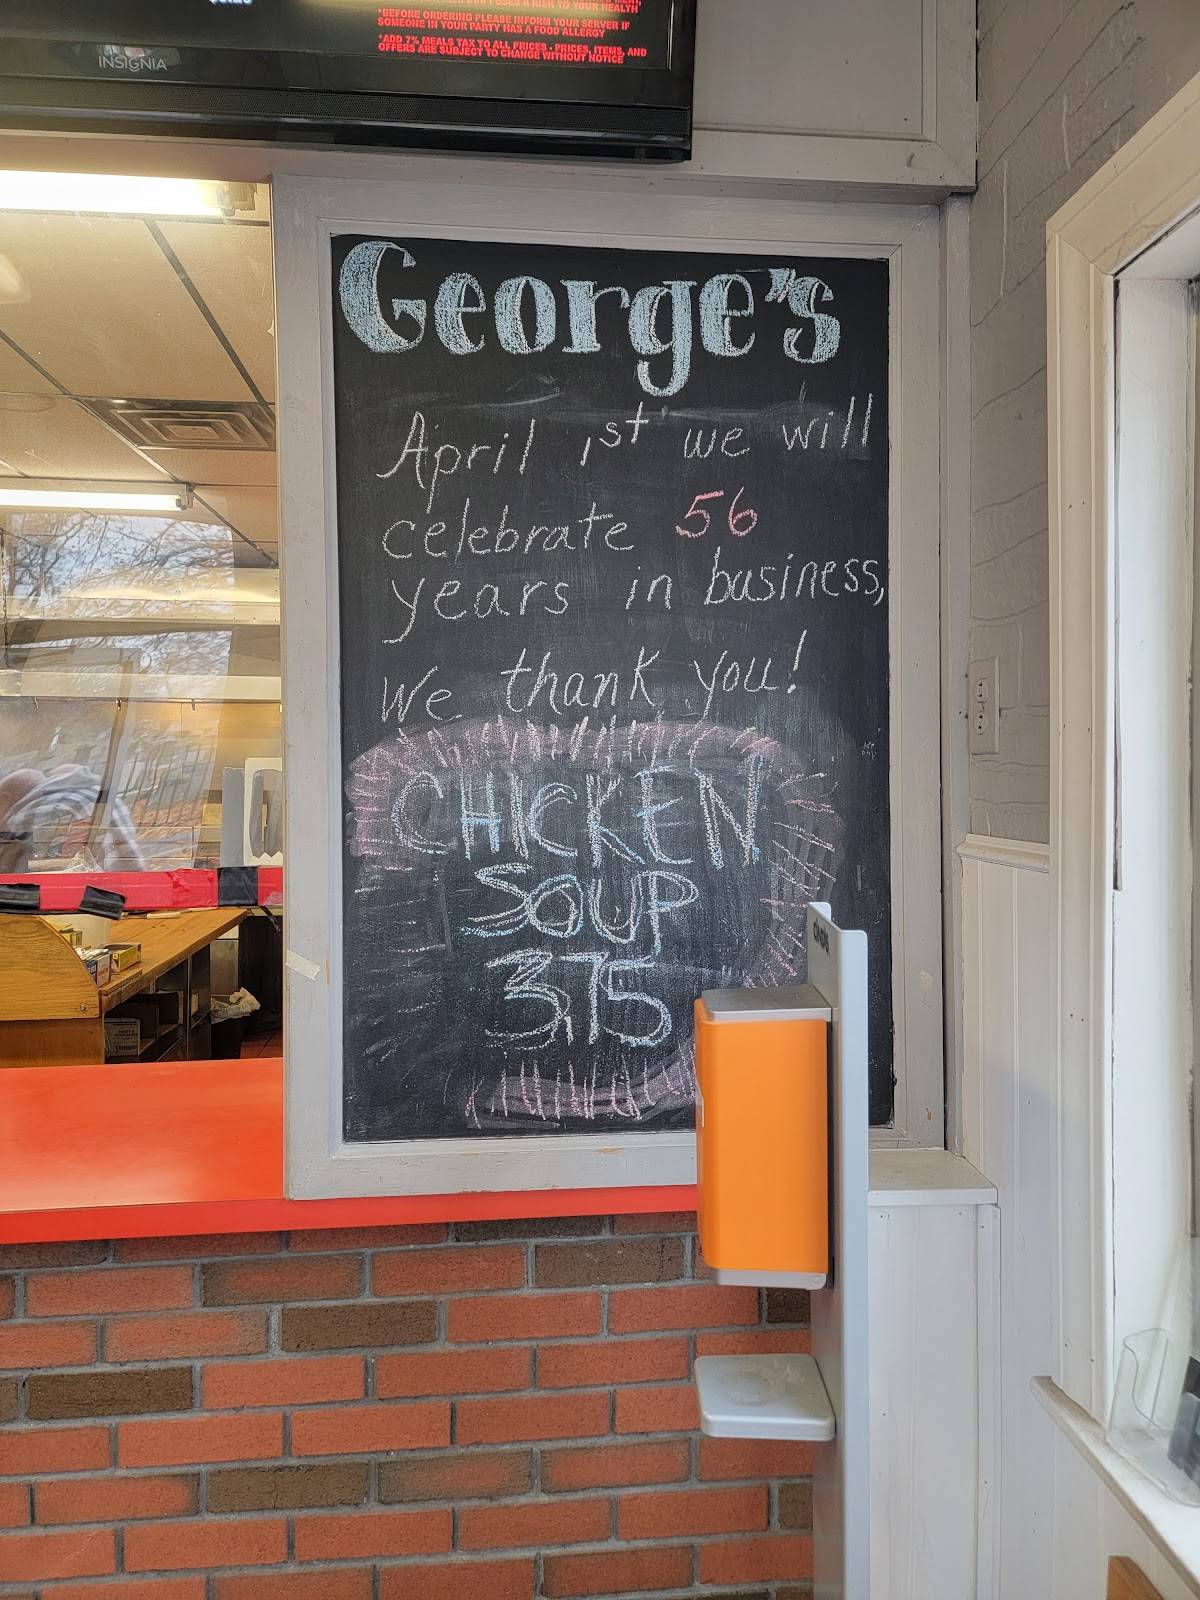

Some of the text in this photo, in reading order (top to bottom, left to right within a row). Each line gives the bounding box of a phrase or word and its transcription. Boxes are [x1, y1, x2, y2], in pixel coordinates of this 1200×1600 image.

[377, 17, 605, 38] SOMEONE IN YOUR PARTY HAS A FOOD ALLERGY
[423, 11, 473, 22] ORDERING
[475, 13, 511, 24] PLEASE
[514, 15, 551, 26] INFORM
[554, 18, 580, 28] YOUR
[582, 20, 618, 30] SERVER
[621, 21, 631, 31] IF
[571, 2, 599, 11] YOUR
[600, 4, 639, 13] HEALTH
[98, 55, 168, 72] INSIGNIA
[378, 43, 624, 64] OFFERS ARE SUBJECT TO CHANGE WITHOUT NOTICE
[405, 35, 419, 45] 7%
[422, 36, 454, 47] MEALS
[457, 38, 475, 48] TAX
[478, 39, 490, 49] TO
[493, 40, 510, 50] ALL
[555, 43, 591, 53] PRICES,
[594, 44, 625, 56] ITEMS,
[628, 47, 647, 57] AND
[338, 240, 842, 398] George's
[376, 410, 536, 514] April
[683, 424, 751, 460] we
[782, 393, 874, 450] will
[381, 487, 759, 560] celebrate 56
[382, 546, 886, 645] years in business,
[381, 628, 808, 723] We thank you!
[390, 755, 764, 871] CHICKEN
[458, 863, 701, 956] SOUP
